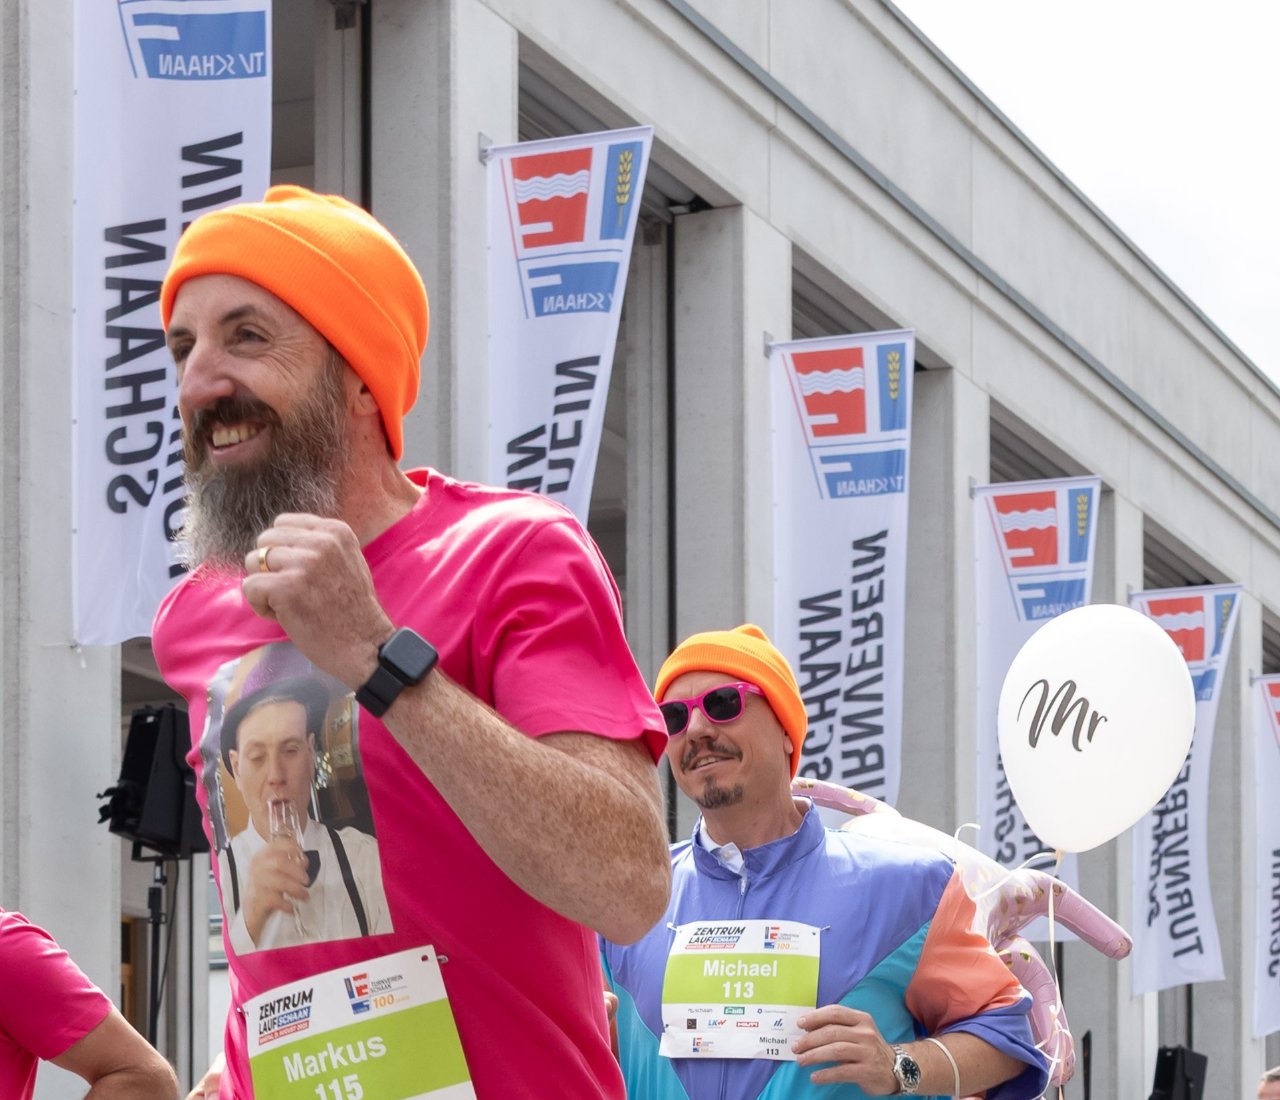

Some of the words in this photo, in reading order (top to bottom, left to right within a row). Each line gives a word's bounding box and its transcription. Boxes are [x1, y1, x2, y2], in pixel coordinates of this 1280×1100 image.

[1017, 678, 1108, 753] Mr
[694, 926, 746, 936] ZENTRUM
[703, 959, 778, 977] Michael
[722, 981, 754, 998] 113
[260, 988, 314, 1021] ZENTRUM
[373, 994, 395, 1009] 100
[259, 1018, 277, 1034] LAUF
[759, 1036, 787, 1045] Michael
[282, 1035, 388, 1083] Markus
[766, 1048, 779, 1056] 113
